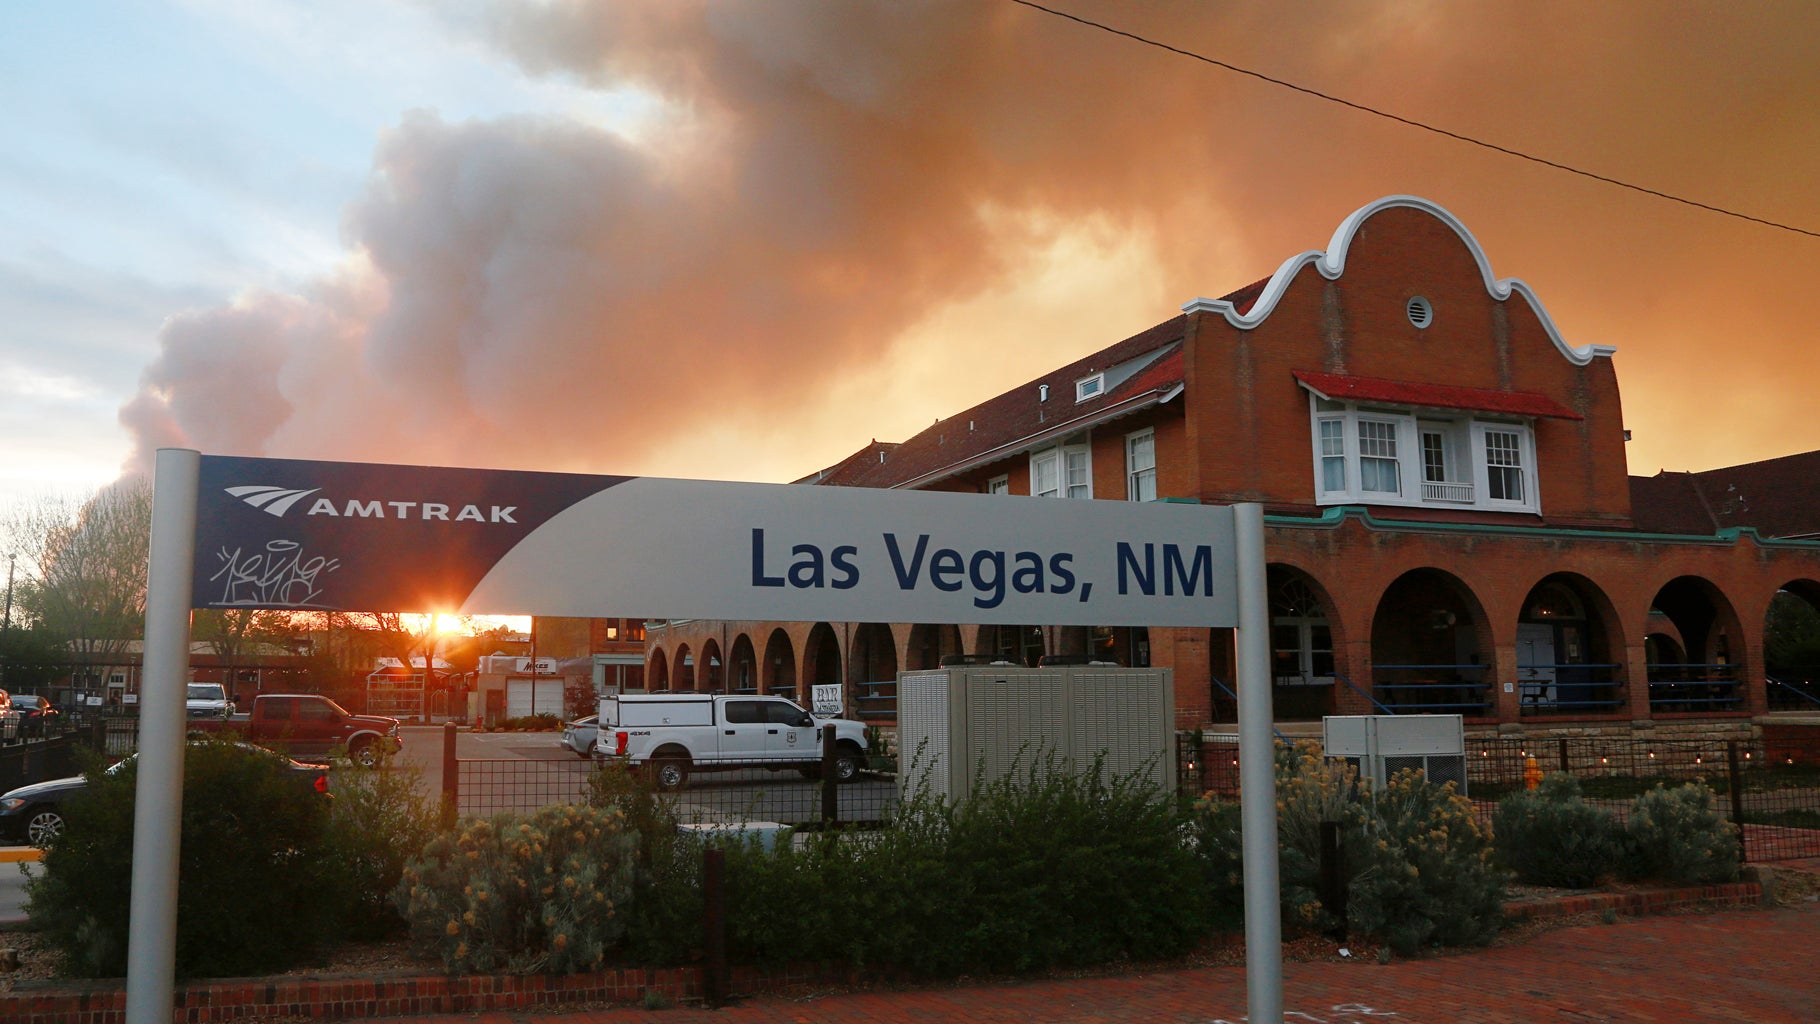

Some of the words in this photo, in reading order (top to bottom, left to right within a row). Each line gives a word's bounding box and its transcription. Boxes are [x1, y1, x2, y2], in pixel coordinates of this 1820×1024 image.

[307, 498, 517, 523] AMTRAK
[751, 527, 860, 590] Las
[882, 532, 1093, 609] Vegas,
[1116, 541, 1214, 597] NM
[816, 687, 838, 702] BAR
